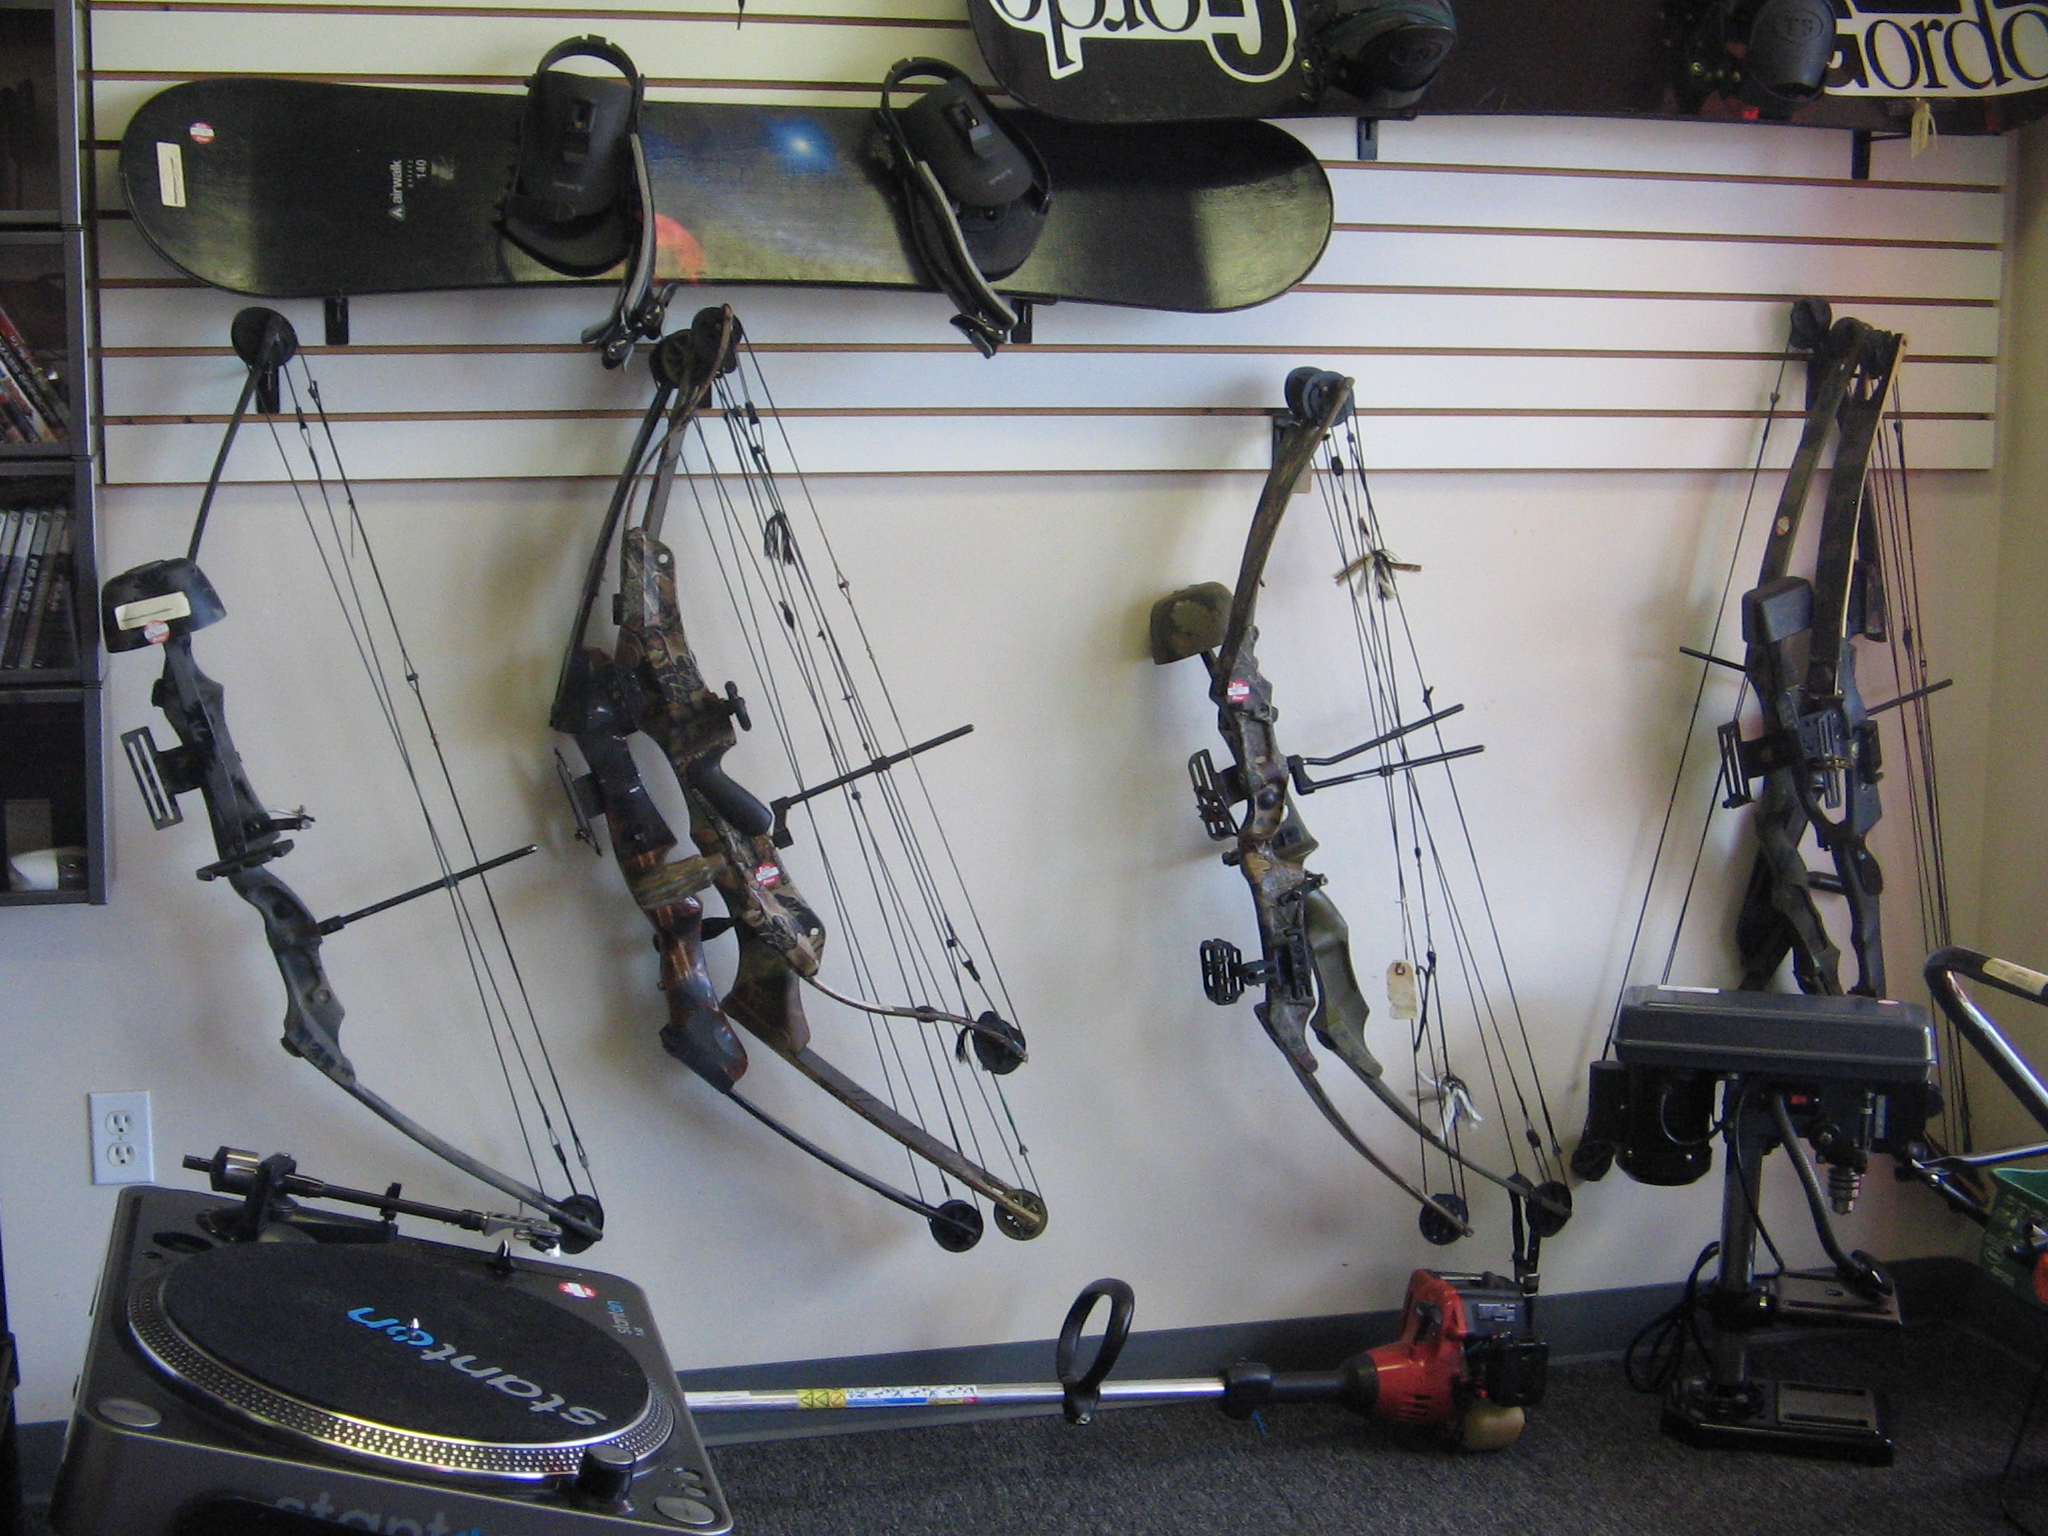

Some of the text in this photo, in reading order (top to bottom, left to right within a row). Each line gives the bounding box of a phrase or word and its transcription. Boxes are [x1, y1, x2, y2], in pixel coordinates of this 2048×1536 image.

[389, 160, 403, 204] airwalk
[415, 159, 427, 179] 140
[347, 1306, 608, 1426] stanton
